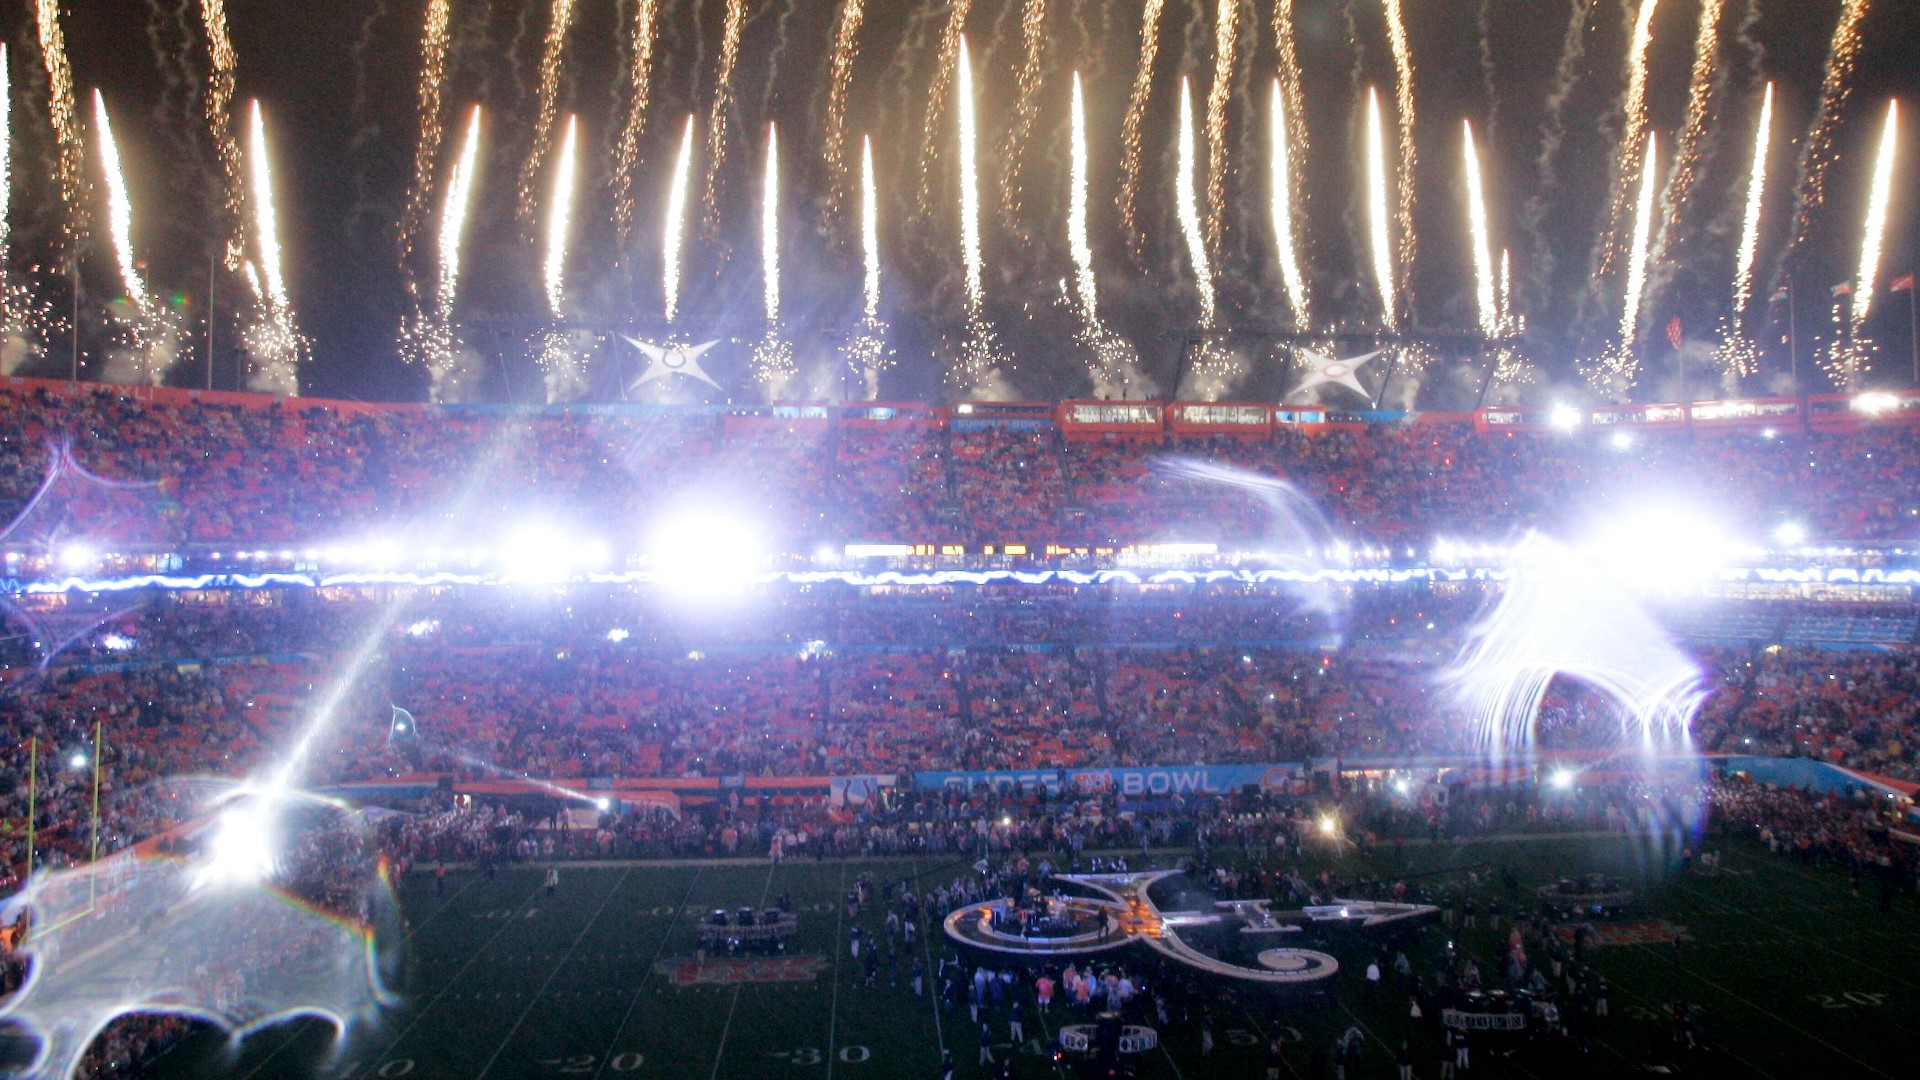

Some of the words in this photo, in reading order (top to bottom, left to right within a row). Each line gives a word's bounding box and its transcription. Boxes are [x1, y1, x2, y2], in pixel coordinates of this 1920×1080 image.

[587, 405, 615, 415] ONE
[1123, 770, 1219, 795] BOWL
[558, 1053, 644, 1073] 20
